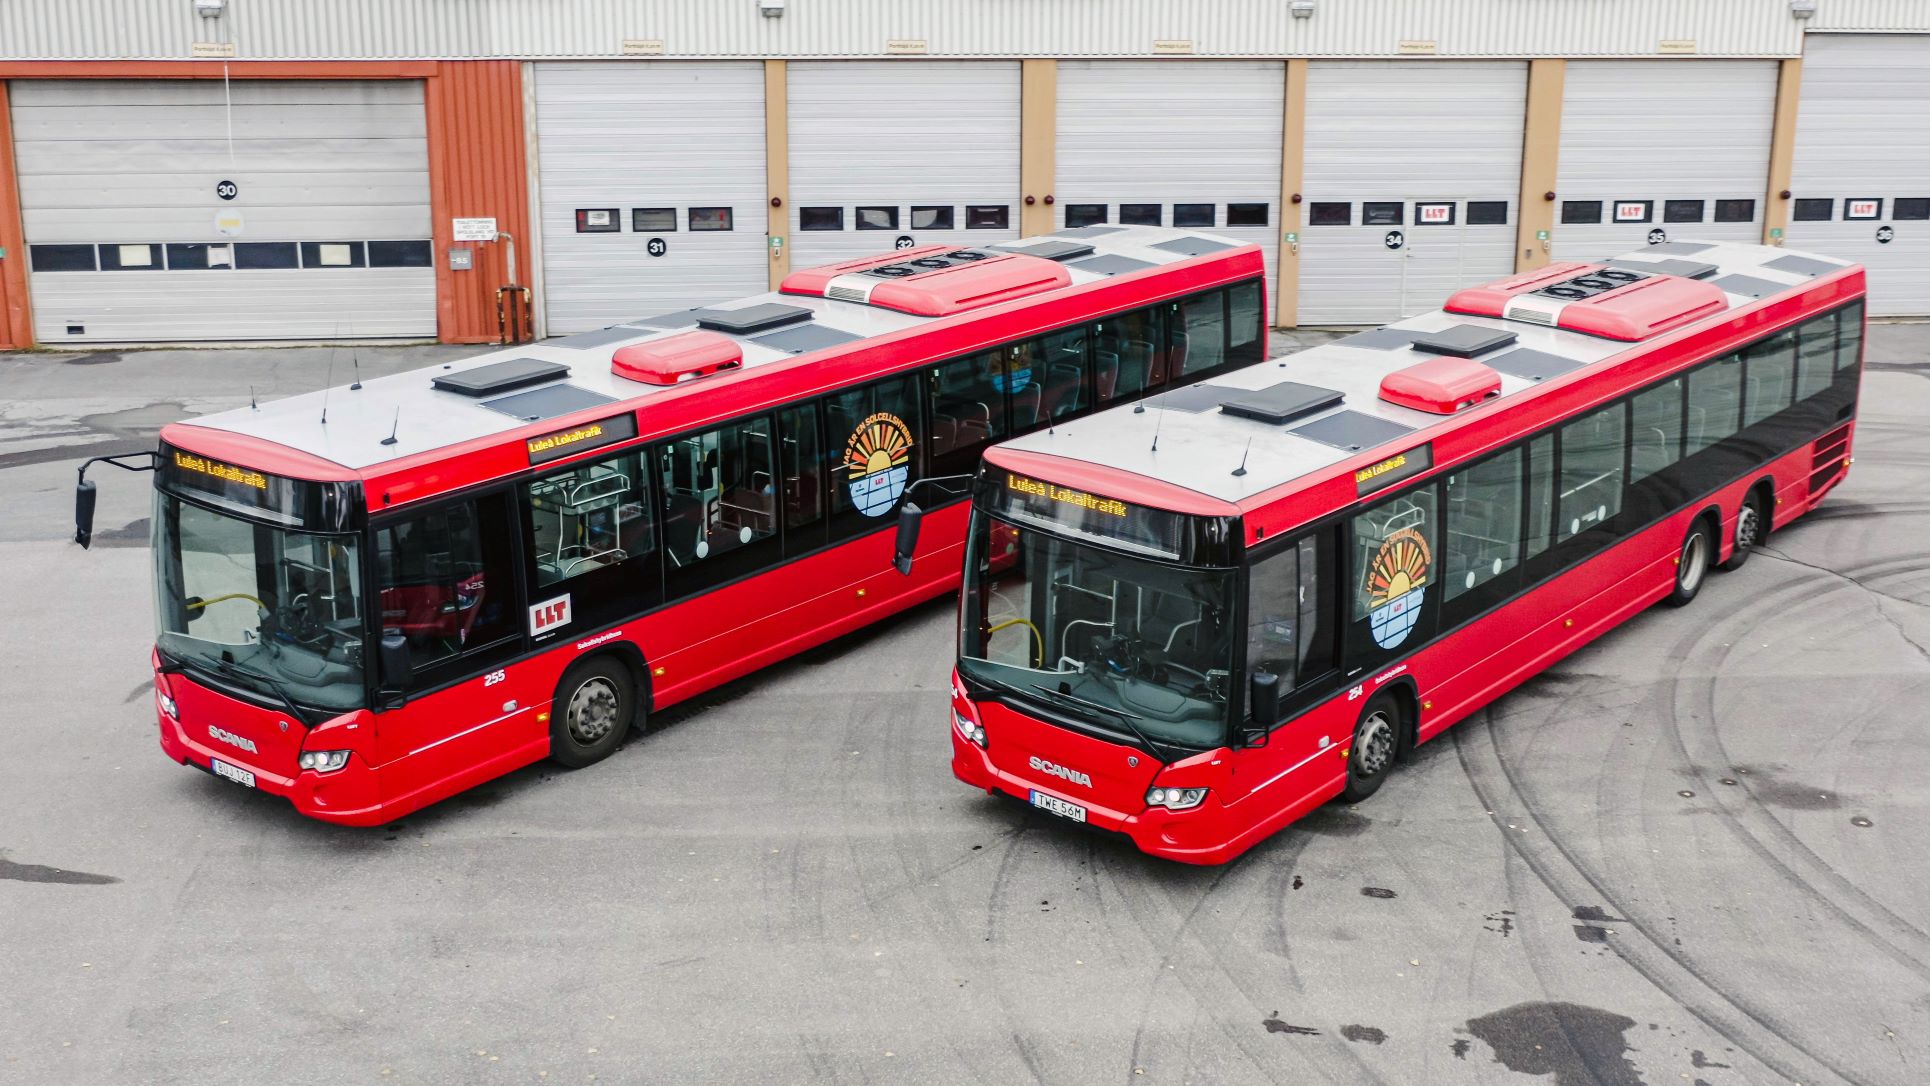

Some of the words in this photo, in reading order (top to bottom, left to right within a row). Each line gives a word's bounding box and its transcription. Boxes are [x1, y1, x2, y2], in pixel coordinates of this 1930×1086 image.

[218, 184, 237, 197] 30
[1425, 208, 1445, 219] LLT
[1621, 206, 1641, 217] LLT
[897, 239, 913, 250] 32
[1386, 234, 1403, 246] 34
[1648, 232, 1665, 244] 35
[650, 242, 665, 254] 31
[528, 438, 555, 454] Luleå
[555, 425, 603, 447] Lokaltrafik
[842, 447, 853, 465] JAG
[855, 421, 866, 436] EN
[864, 412, 913, 447] SOLCELLSHYBRID
[176, 452, 205, 472] Luleå
[207, 460, 266, 489] Lokaltrafik
[1008, 474, 1046, 497] Luleå
[1050, 485, 1127, 517] Lokaltrafik
[535, 600, 567, 630] LLT
[484, 669, 506, 687] 255
[1347, 684, 1364, 701] 254
[208, 725, 258, 755] SCANIA
[1029, 756, 1093, 788] SCANIA
[1038, 794, 1058, 811] TWE
[1061, 802, 1081, 819] 56M
